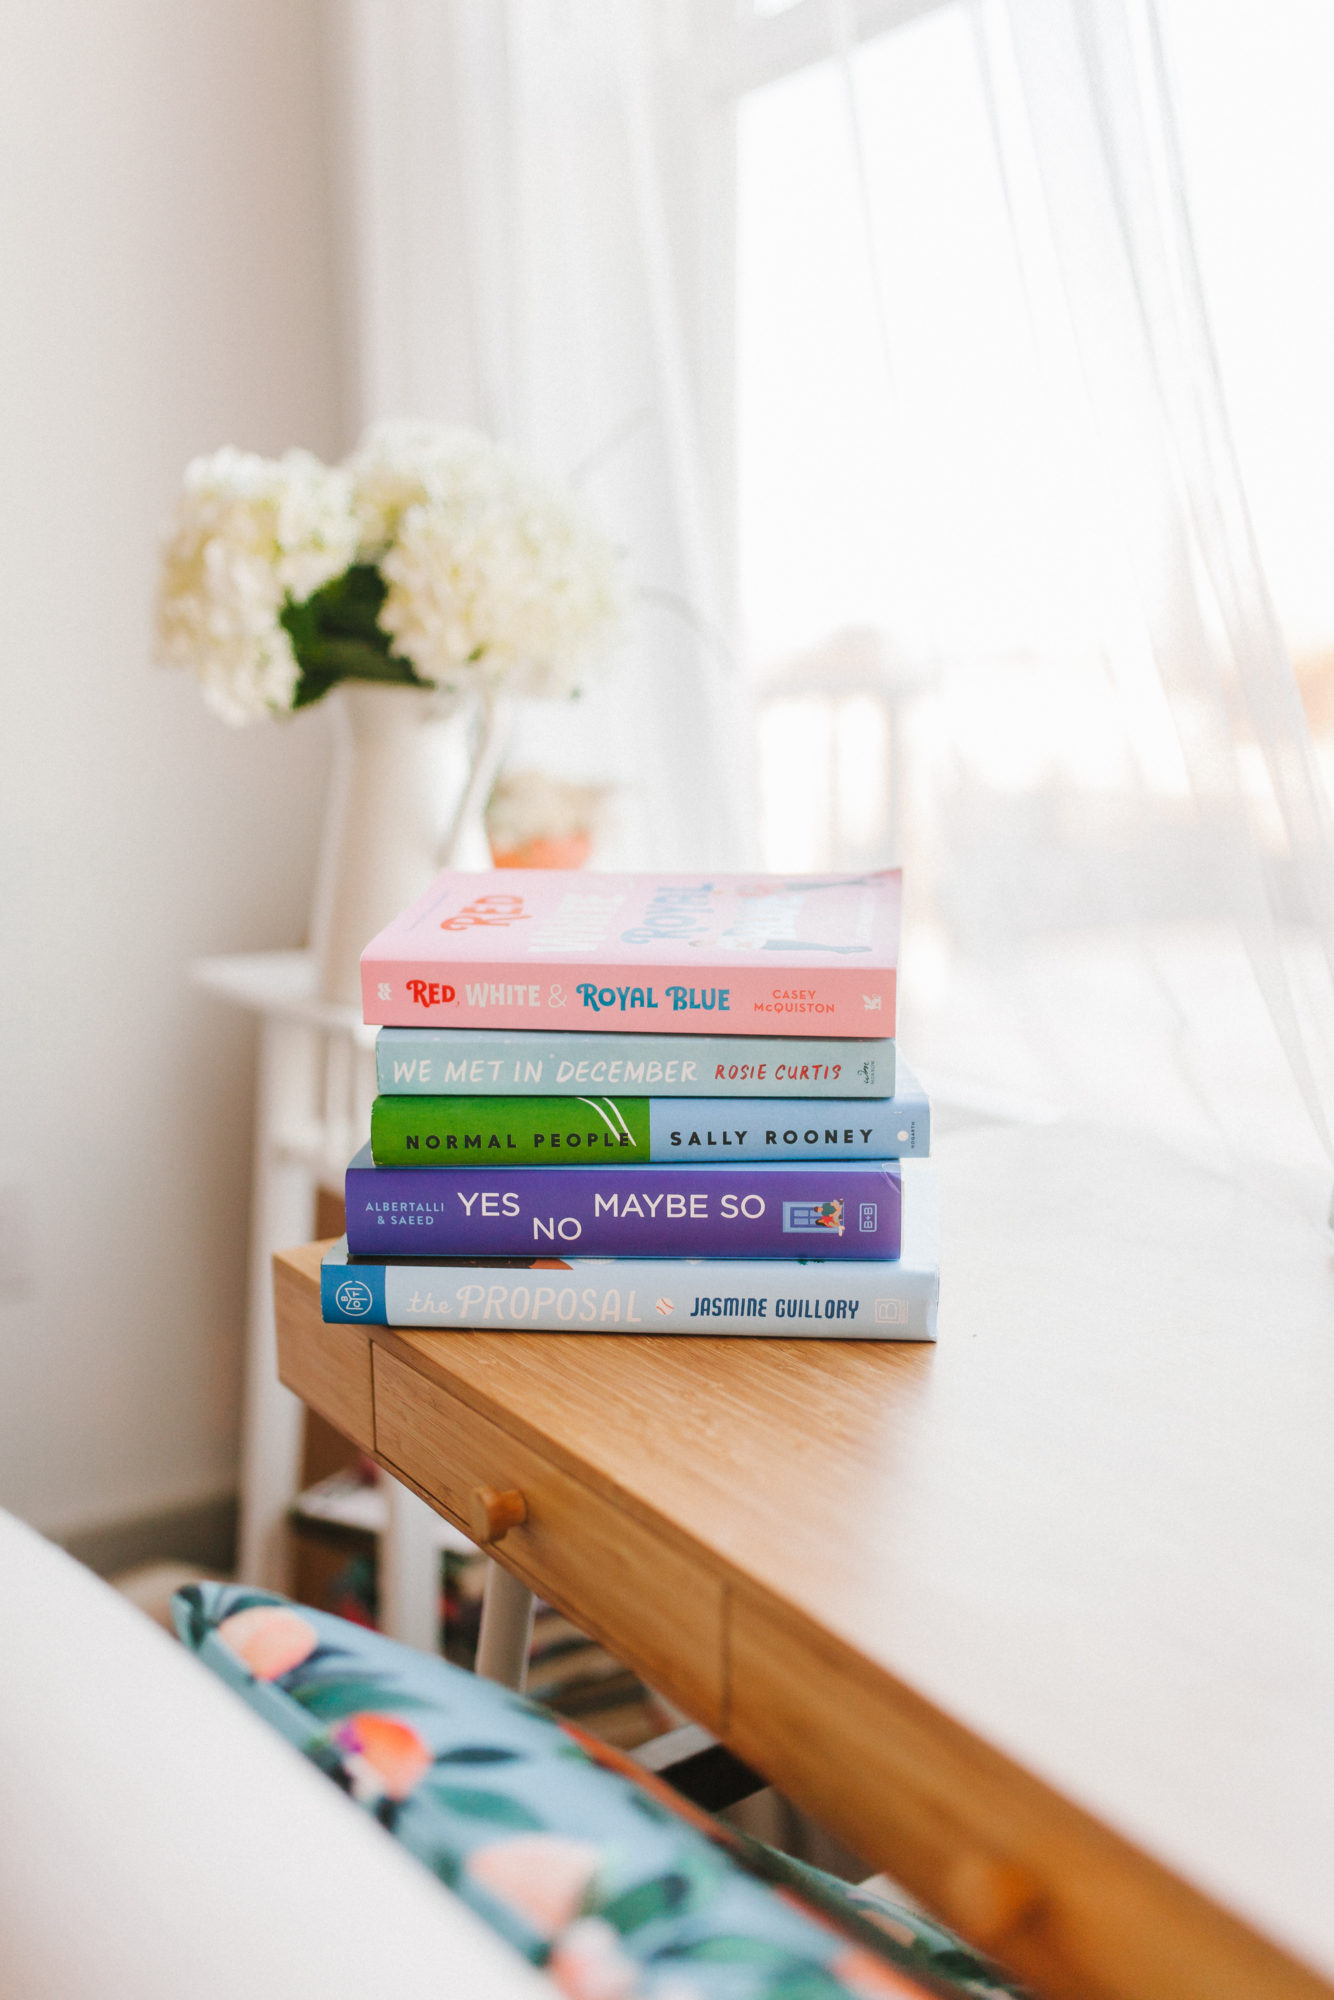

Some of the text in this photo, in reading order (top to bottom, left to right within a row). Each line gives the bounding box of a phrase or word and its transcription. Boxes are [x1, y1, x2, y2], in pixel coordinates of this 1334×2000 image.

[465, 982, 541, 1008] WHITE
[548, 984, 567, 1008] &
[576, 983, 658, 1012] ROYAL
[665, 986, 730, 1011] BLUE
[772, 989, 817, 1000] CASEY
[394, 1060, 698, 1084] WE MET IN DECEMBER
[714, 1064, 842, 1081] ROSIE CURTIS
[406, 1132, 629, 1150] NORMAL PEOPLE
[670, 1129, 873, 1147] SALLY ROONEY
[365, 1202, 445, 1212] ALBERTALLI
[377, 1215, 434, 1225] & SAEED
[457, 1192, 766, 1241] YES NO MAYBE SO
[406, 1284, 643, 1323] the PROPOSAL
[690, 1297, 860, 1320] JASMINE GUILLORY
